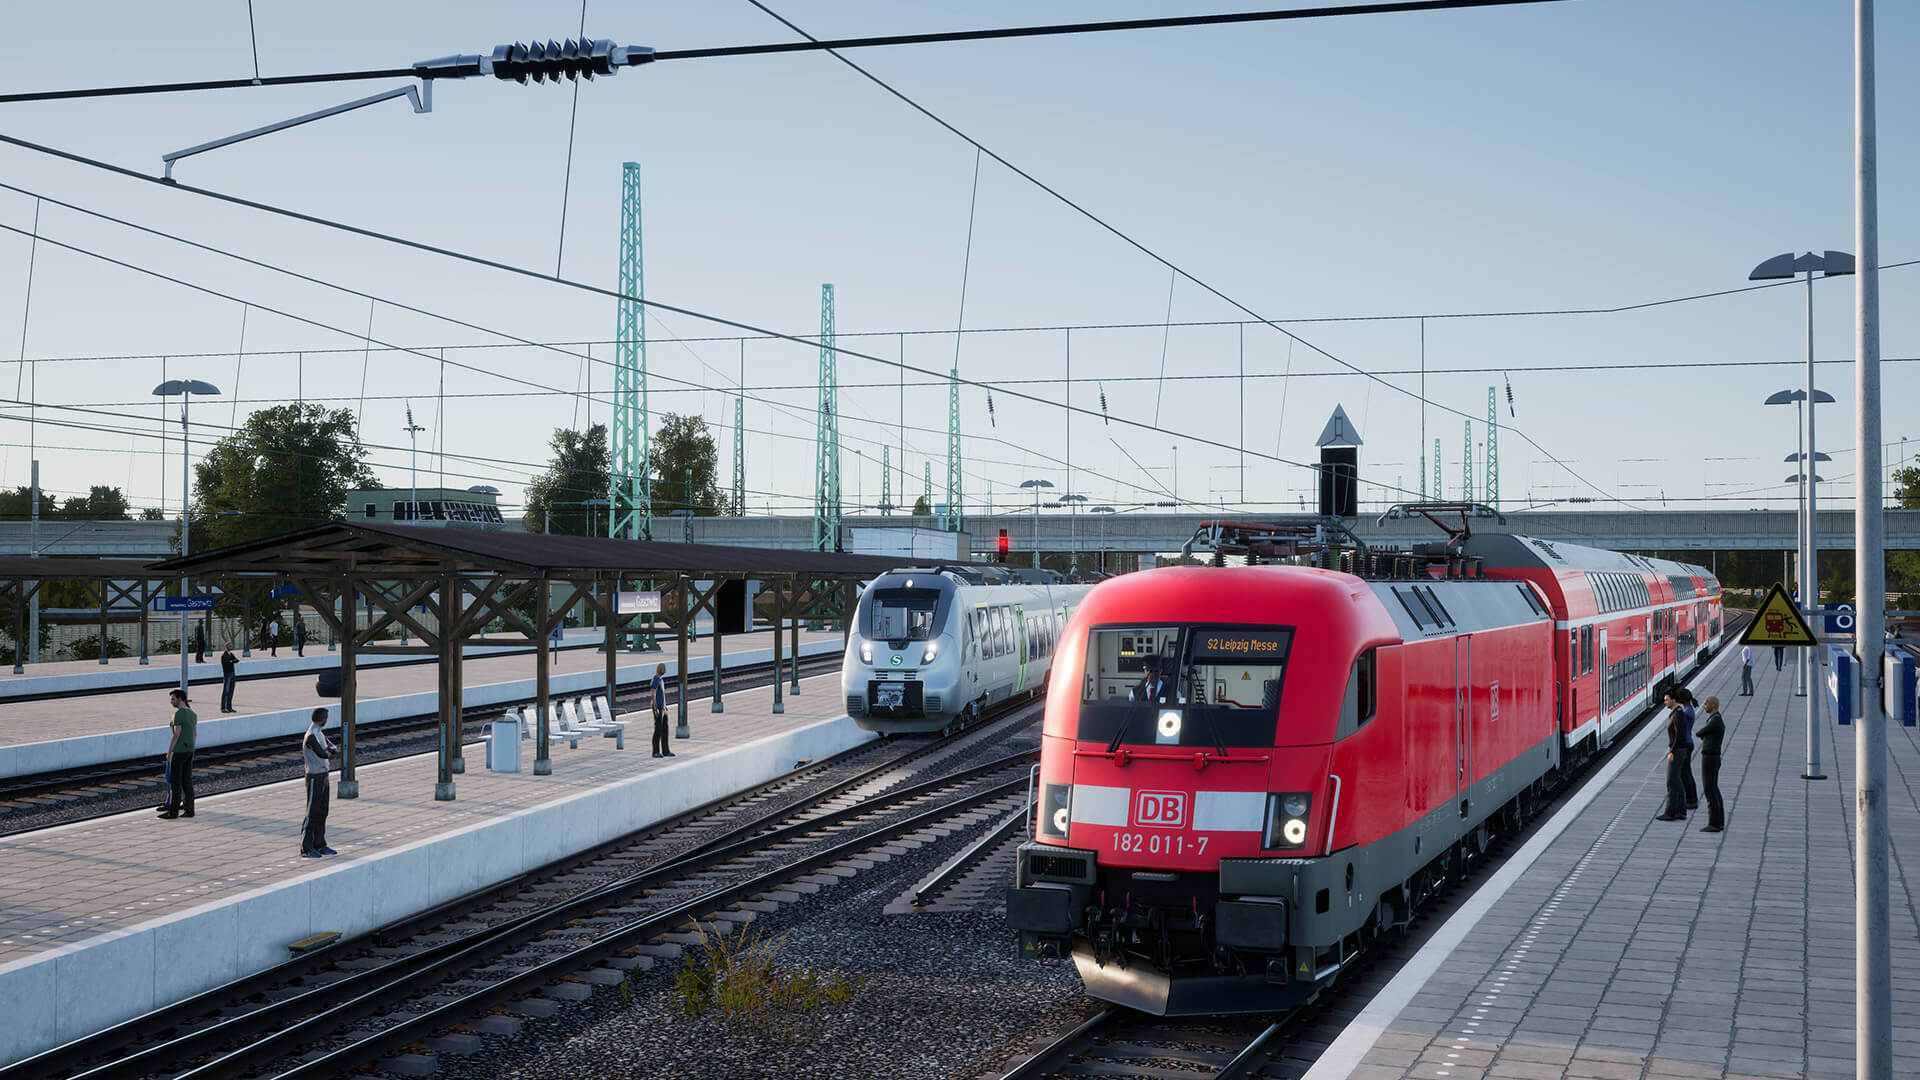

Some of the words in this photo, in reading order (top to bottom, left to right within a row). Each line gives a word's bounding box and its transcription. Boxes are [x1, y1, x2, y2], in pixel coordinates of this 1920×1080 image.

[1836, 604, 1854, 629] 8
[1207, 638, 1218, 650] S2
[1220, 638, 1249, 653] Leipzig
[1251, 639, 1278, 651] Messe
[892, 655, 901, 665] S
[1140, 796, 1180, 822] DB
[1112, 832, 1143, 853] 182
[1150, 835, 1209, 855] 011-7
